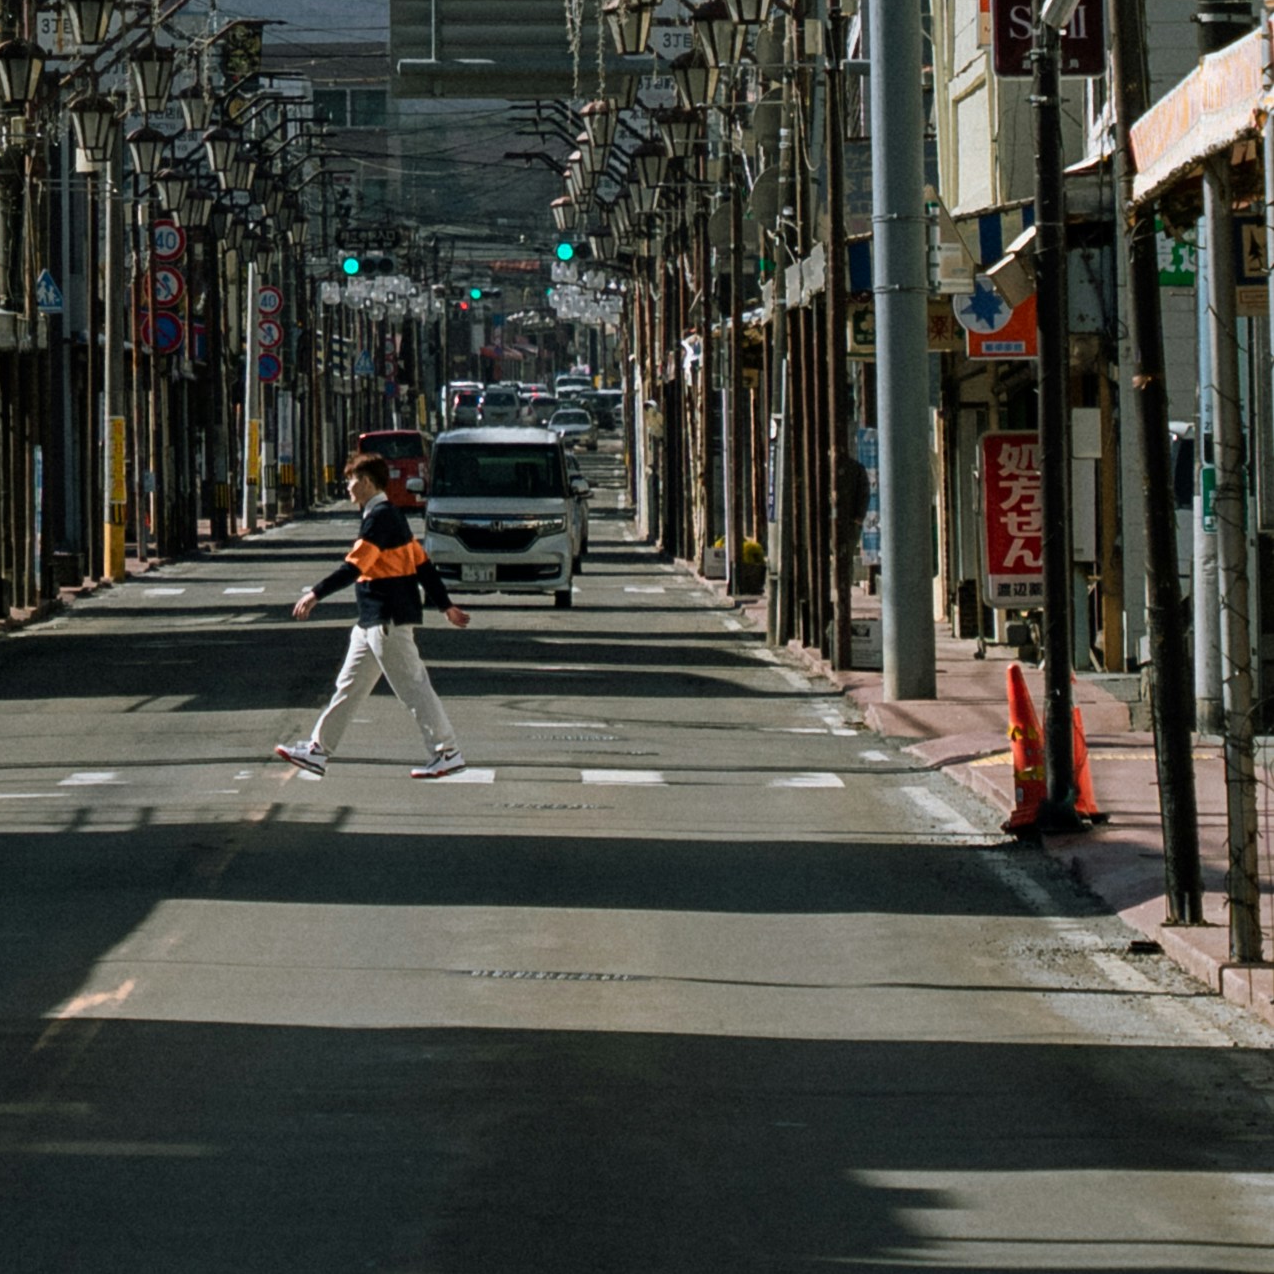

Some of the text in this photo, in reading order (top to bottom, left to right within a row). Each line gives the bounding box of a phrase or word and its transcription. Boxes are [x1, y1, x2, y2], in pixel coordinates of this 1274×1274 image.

[156, 233, 176, 249] 40
[260, 294, 276, 308] 40
[997, 442, 1042, 568] 処方せん
